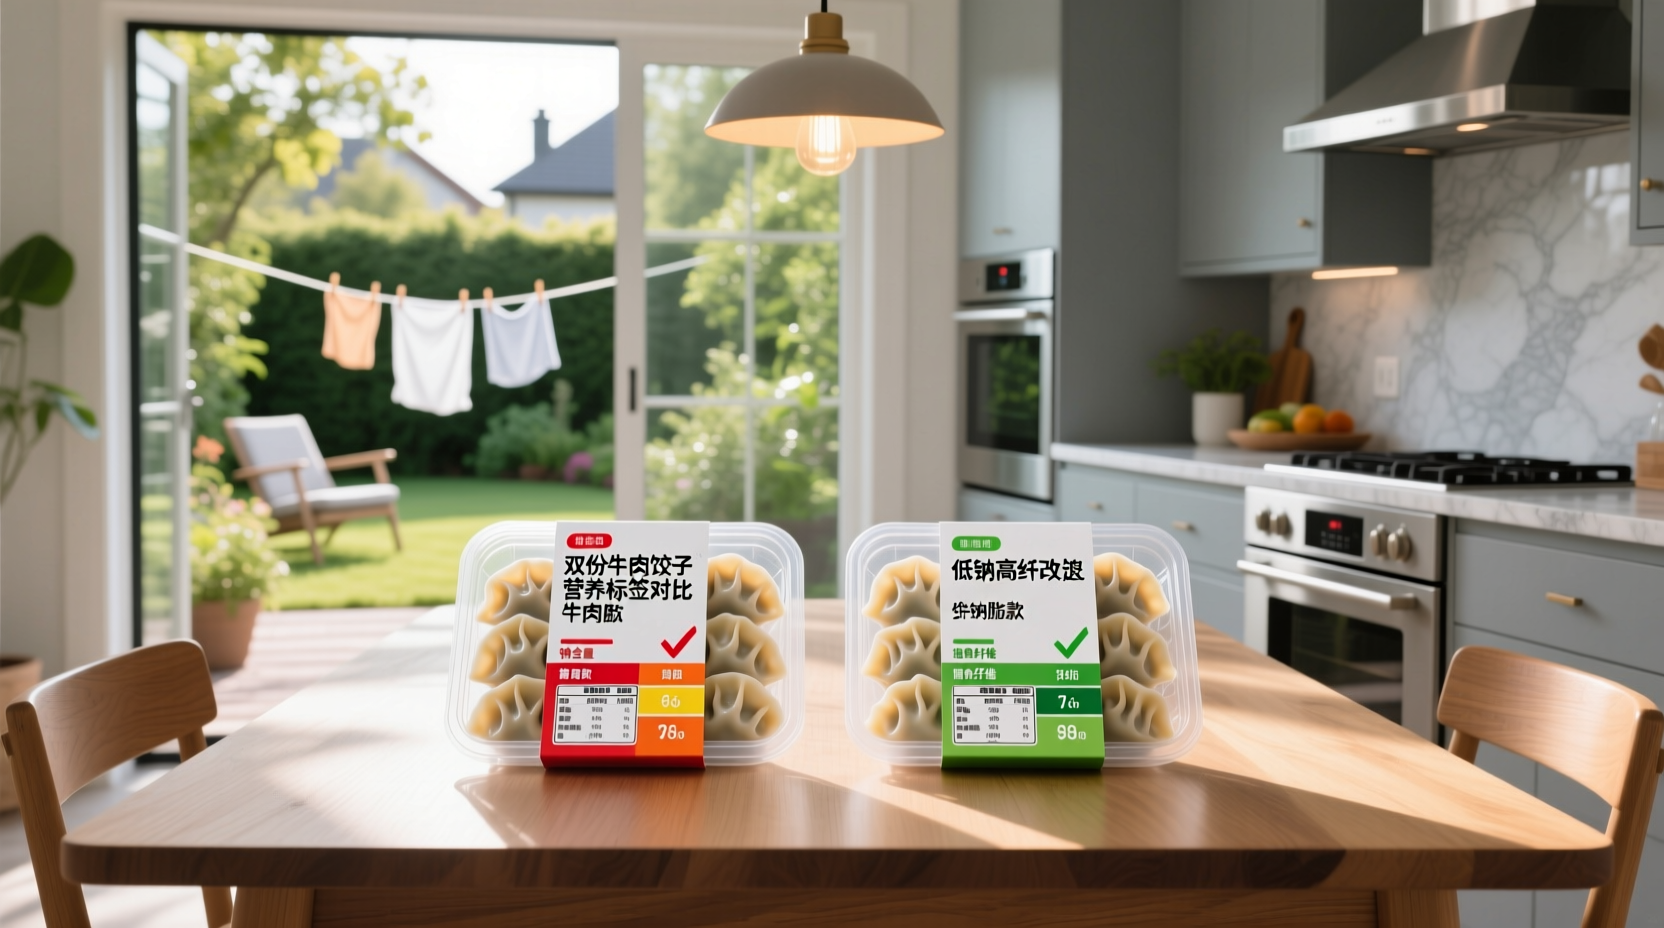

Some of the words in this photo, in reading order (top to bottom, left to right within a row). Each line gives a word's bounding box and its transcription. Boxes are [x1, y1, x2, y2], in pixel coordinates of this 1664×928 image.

[564, 553, 693, 576] 双份牛肉饺子
[563, 577, 693, 601] 营养标签对比
